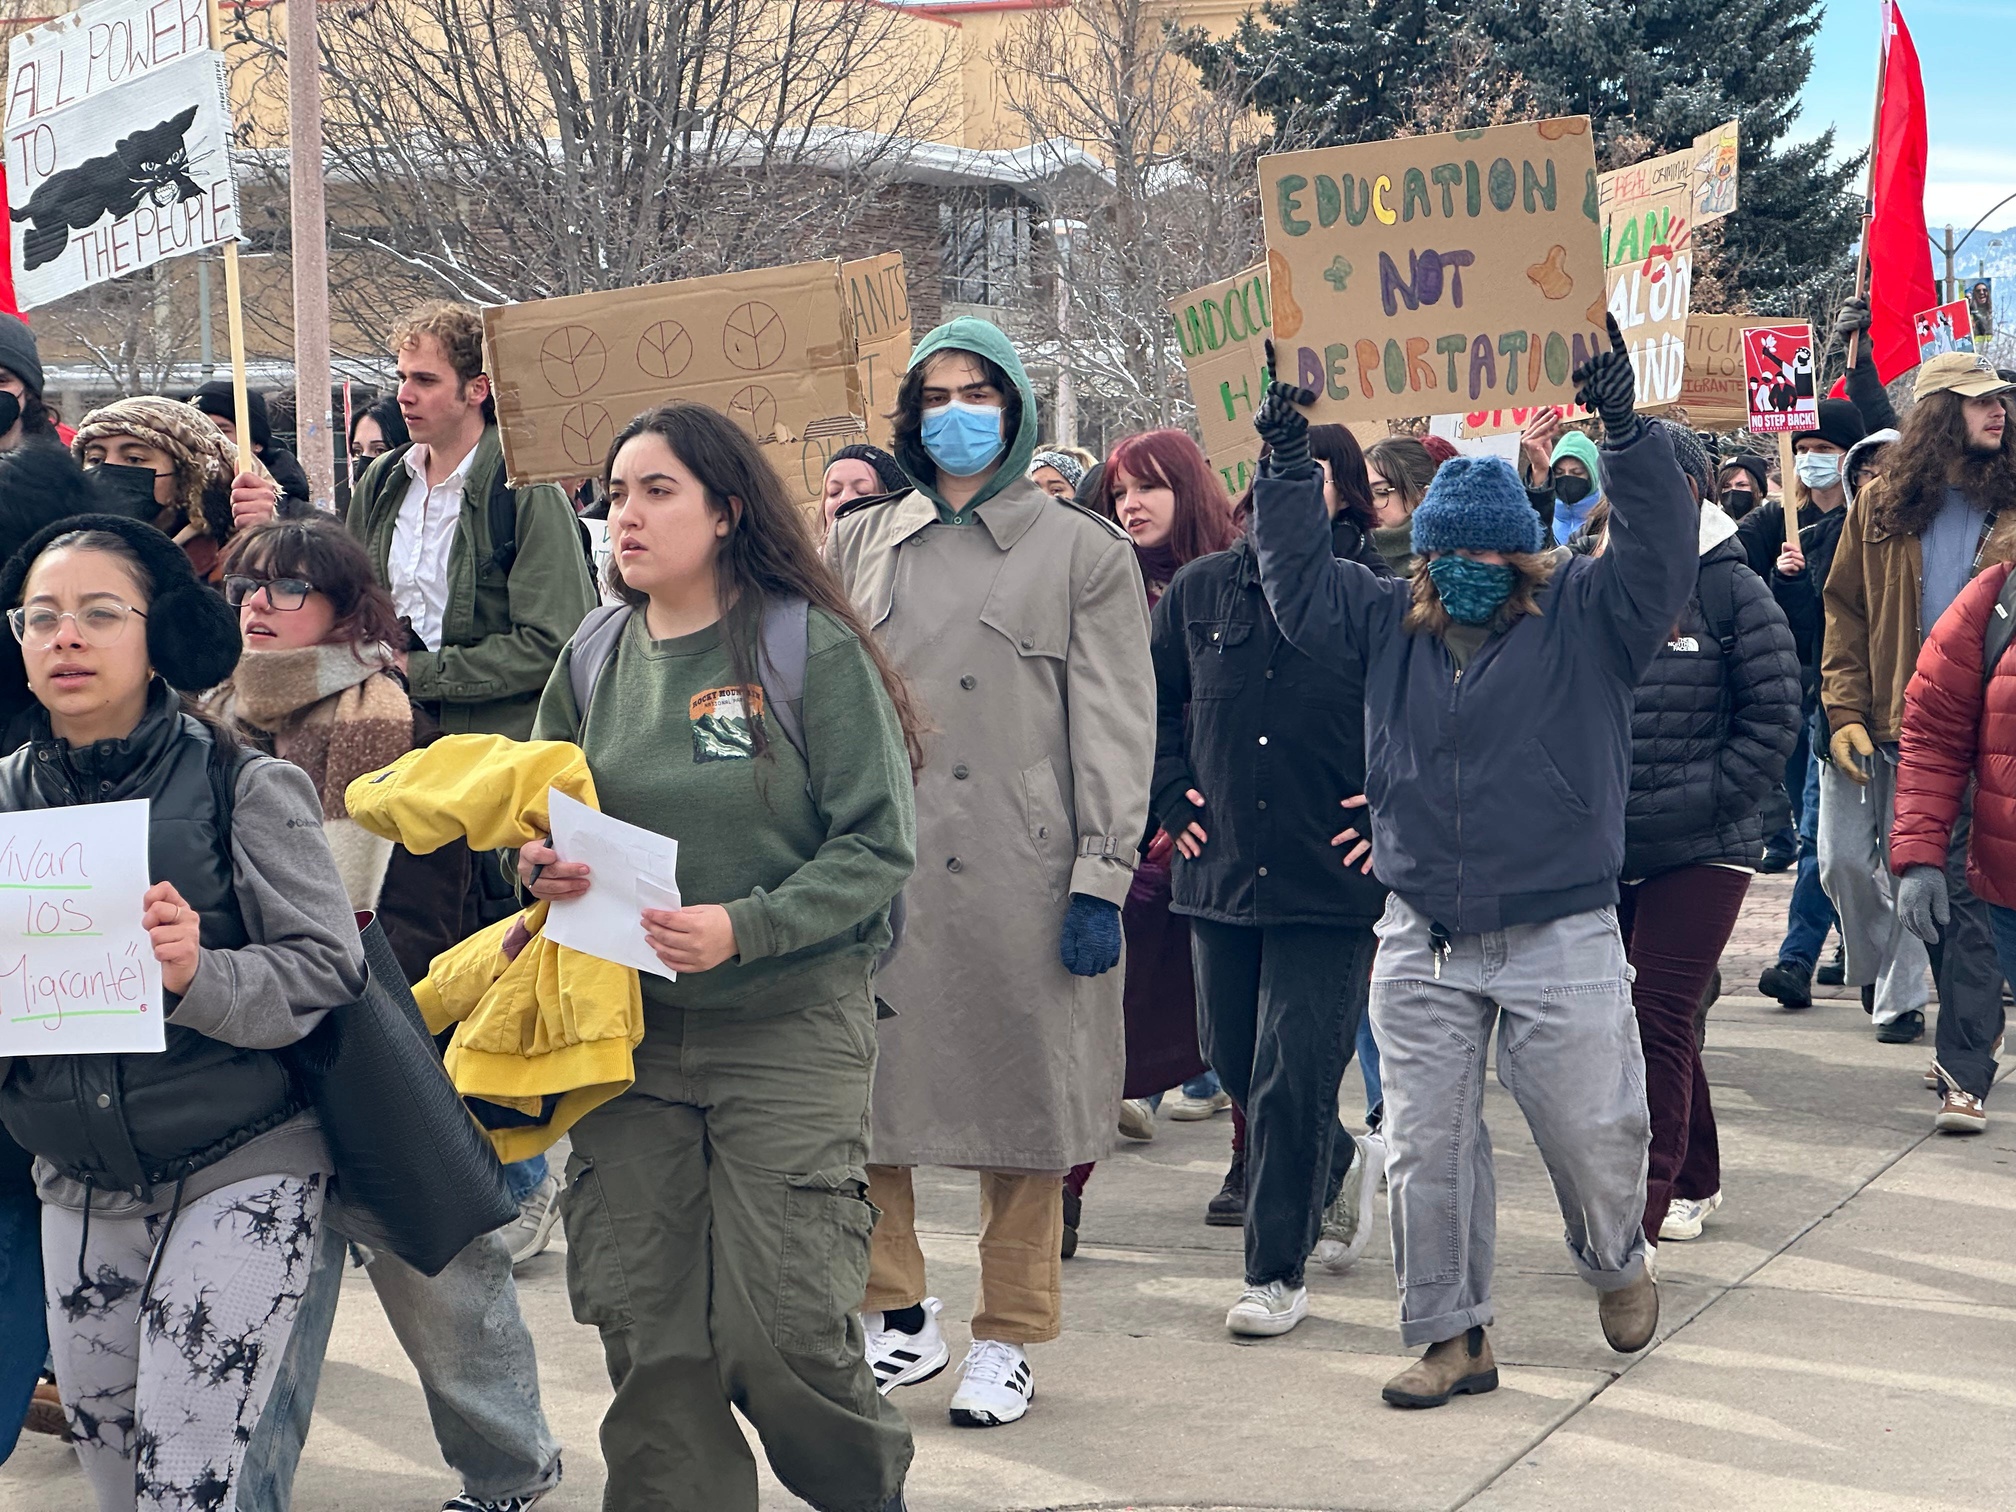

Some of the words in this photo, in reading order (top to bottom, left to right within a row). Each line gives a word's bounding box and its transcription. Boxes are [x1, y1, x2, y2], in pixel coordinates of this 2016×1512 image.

[6, 50, 75, 127] ALL
[86, 0, 203, 93] POWER
[12, 124, 56, 186] TO
[1615, 169, 1651, 198] REAL
[1653, 160, 1693, 184] CRIMINAL
[71, 219, 130, 281] THE
[134, 179, 234, 262] PEOPLE
[1277, 158, 1557, 236] EDUCATION
[851, 263, 909, 338] ANTS
[1379, 247, 1475, 317] NOT
[1298, 330, 1600, 400] DEPORTATION
[1751, 415, 1763, 428] NO
[1765, 413, 1785, 427] STEP
[1787, 412, 1815, 426] BACK!
[692, 691, 718, 709] ROCKY
